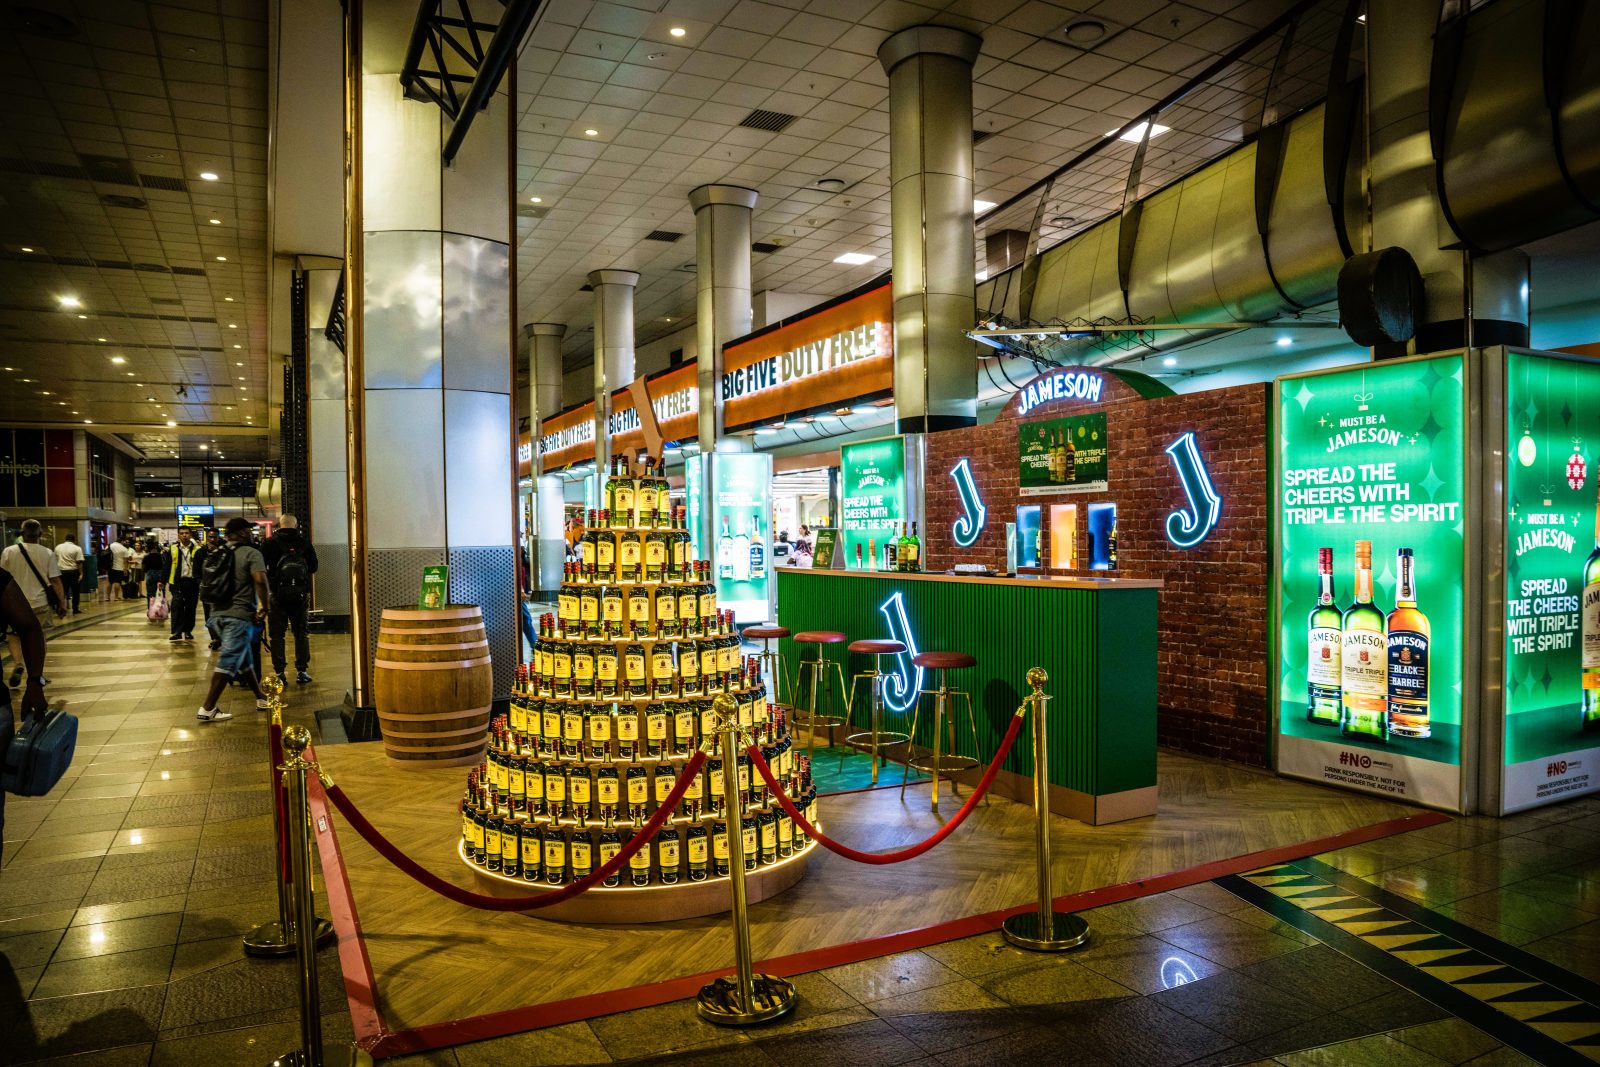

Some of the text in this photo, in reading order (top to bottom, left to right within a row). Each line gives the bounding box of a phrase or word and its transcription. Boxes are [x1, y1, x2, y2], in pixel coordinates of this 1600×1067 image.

[721, 321, 876, 401] BIG FIVE DUTY FREE
[1018, 373, 1103, 415] JAMESON
[608, 411, 621, 435] BIG
[654, 396, 665, 420] TY
[667, 387, 691, 417] FREE
[1339, 414, 1386, 428] MUST BE A
[561, 426, 576, 448] DUTY
[576, 421, 591, 442] FREE
[1326, 428, 1400, 453] JAMESON
[1020, 454, 1040, 463] SPREAD
[1084, 455, 1101, 463] SPIRIT
[1087, 448, 1107, 456] TRIPLE
[858, 475, 885, 489] JAMESON
[1284, 462, 1396, 487] SPREAD THE
[1166, 432, 1221, 548] J
[1284, 483, 1410, 506] CHEERS WITH
[844, 495, 883, 508] SPREAD THE
[950, 458, 986, 547] J
[844, 506, 888, 519] CHEERS WITH
[1284, 502, 1460, 525] TRIPLE THE SPIRIT
[1527, 513, 1565, 525] MUST BE A
[844, 519, 867, 531] TRIPLE
[867, 519, 880, 530] THE
[1515, 528, 1575, 557] JAMESON
[1521, 578, 1567, 597] SPREAD
[1508, 596, 1579, 617] THE CHEERS
[1507, 614, 1579, 636] WITH TRIPLE
[880, 592, 924, 711] J
[1344, 634, 1385, 650] JAMESON
[1387, 636, 1428, 651] JAMESON
[1512, 632, 1574, 655] THE SPIRIT
[1345, 665, 1364, 674] TRIPLE
[1365, 668, 1385, 676] TRIPLE
[1394, 664, 1419, 675] BLACK
[1392, 677, 1421, 688] BARREL
[1324, 766, 1341, 774] DRINK
[1380, 777, 1392, 785] NOT
[1393, 779, 1406, 787] FOR
[1324, 773, 1347, 782] PERSONS
[1347, 777, 1366, 786] UNDER
[1377, 783, 1387, 791] AGE
